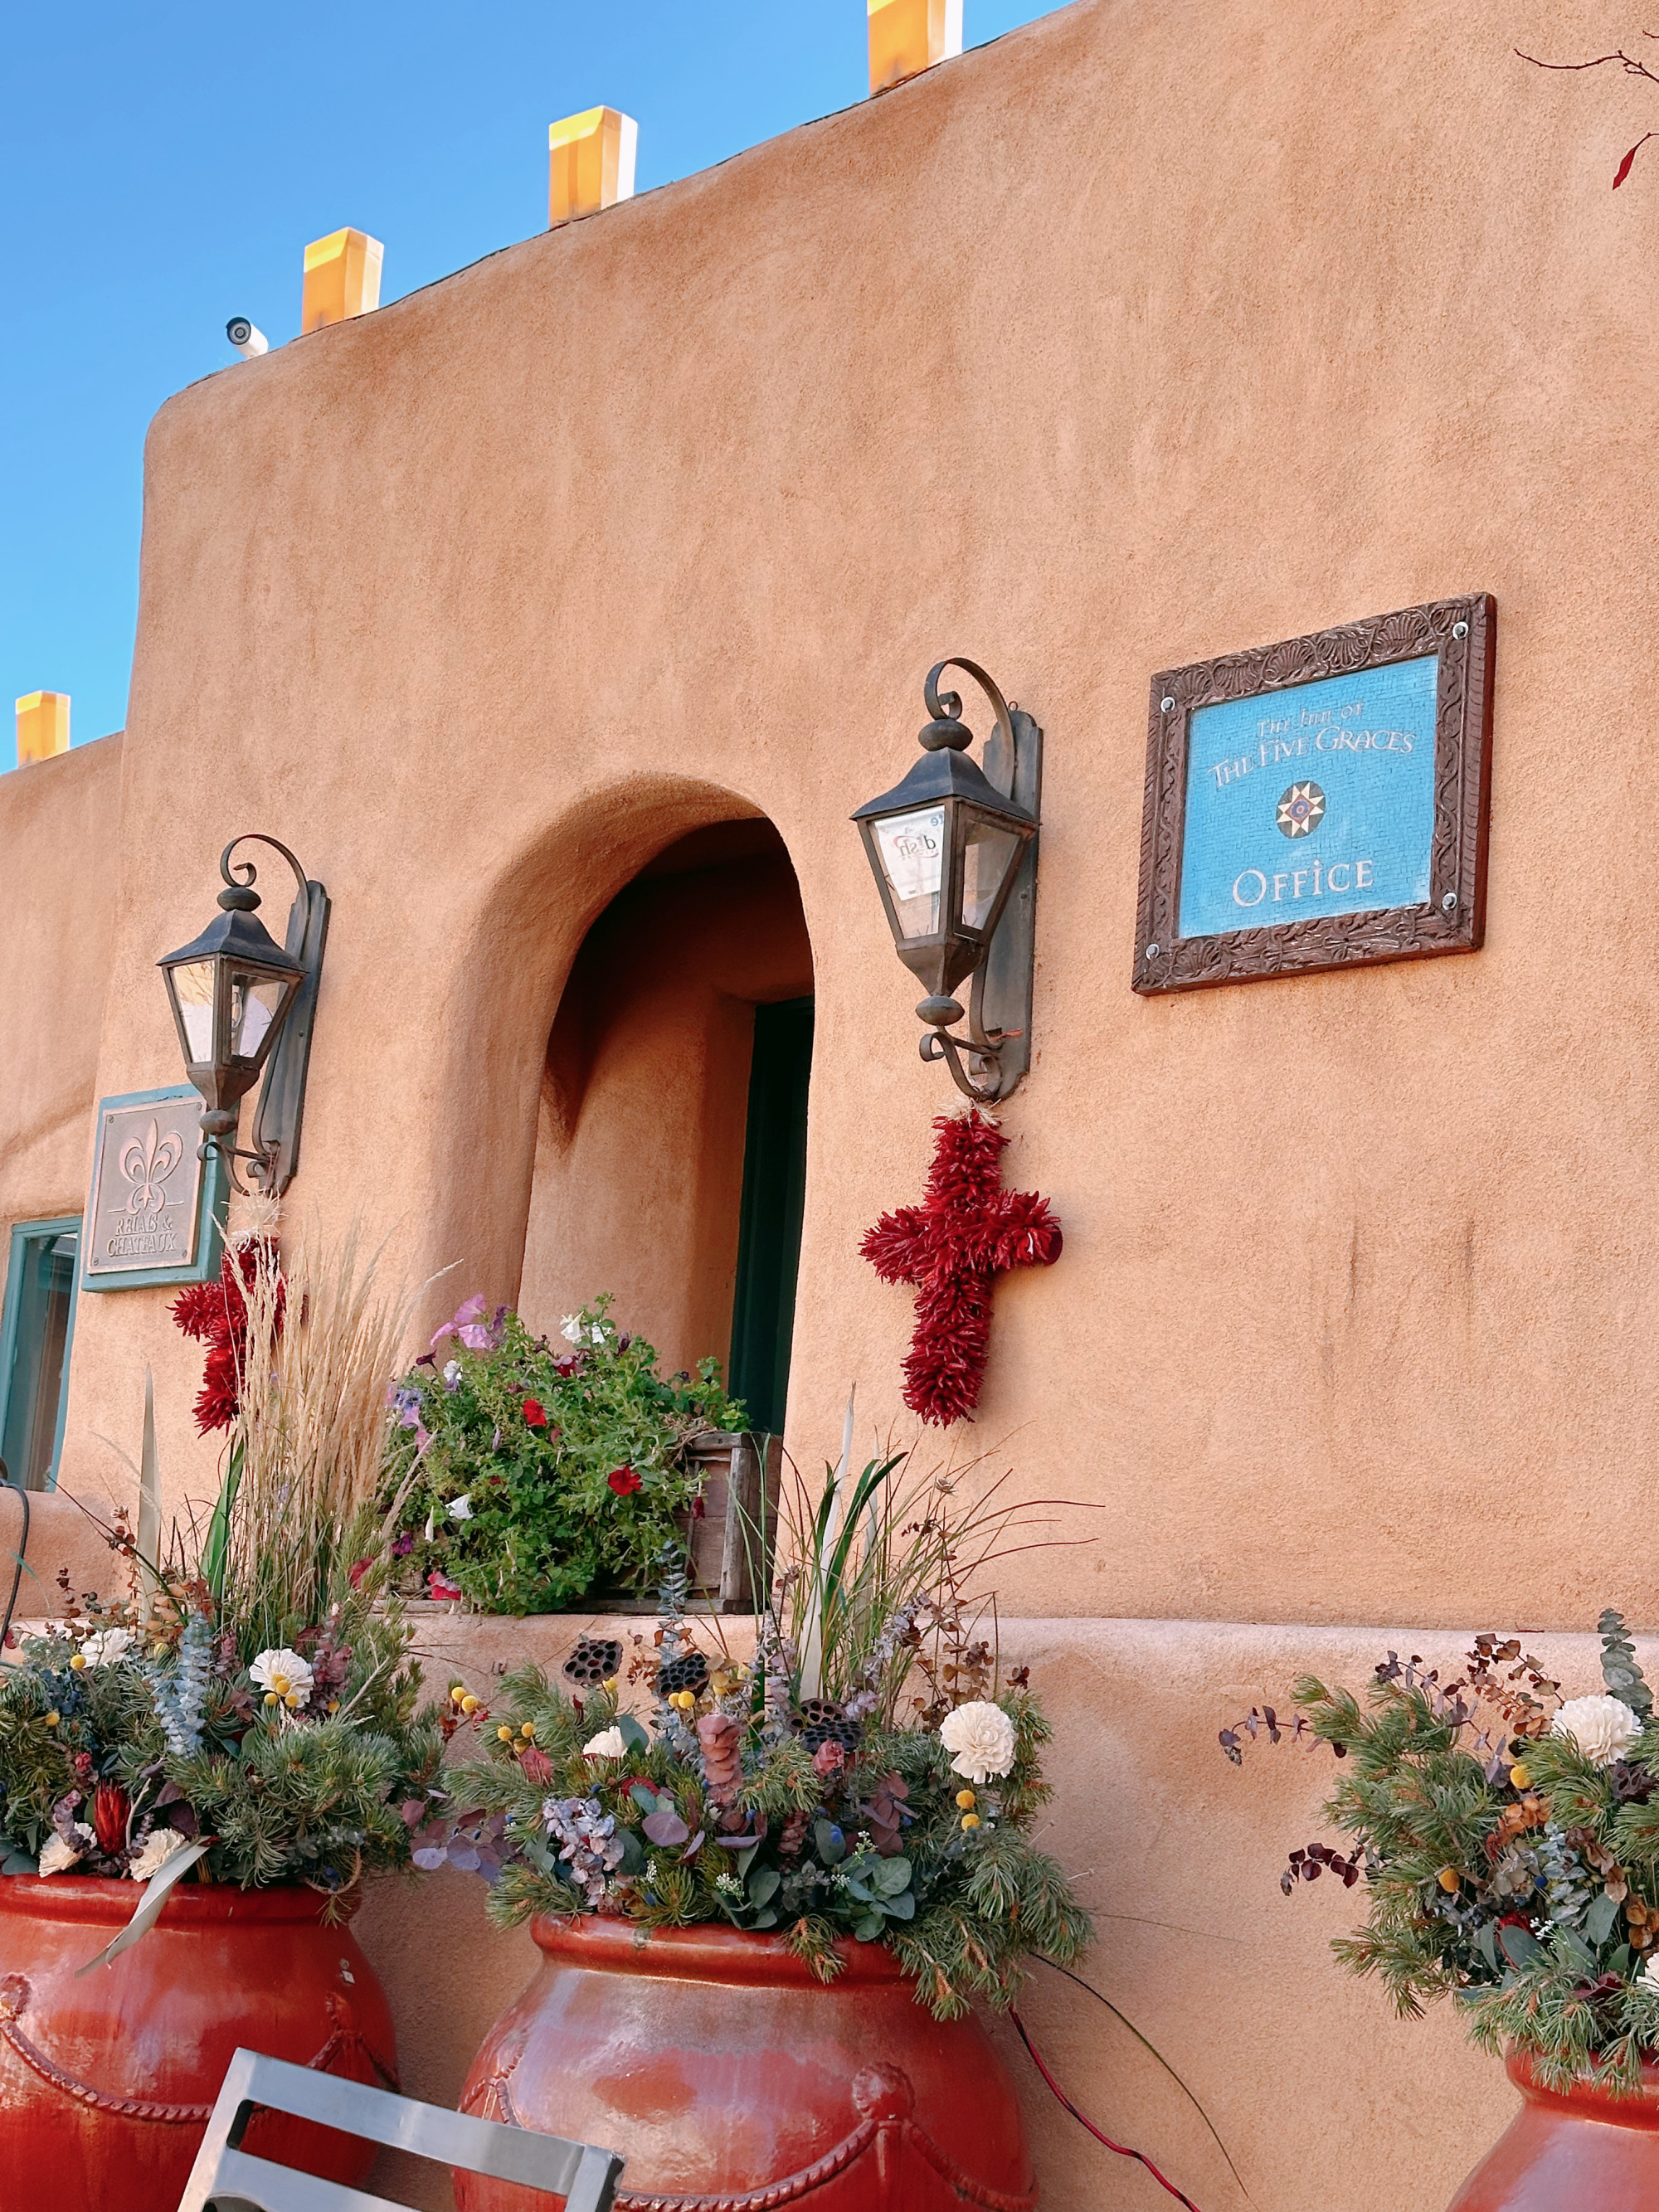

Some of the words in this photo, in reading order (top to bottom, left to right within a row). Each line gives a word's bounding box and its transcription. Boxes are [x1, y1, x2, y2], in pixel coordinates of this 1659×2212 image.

[1208, 754, 1255, 789] THE
[1316, 726, 1417, 754] GRACES
[115, 1214, 158, 1237] RELAIS
[162, 1214, 173, 1232] &
